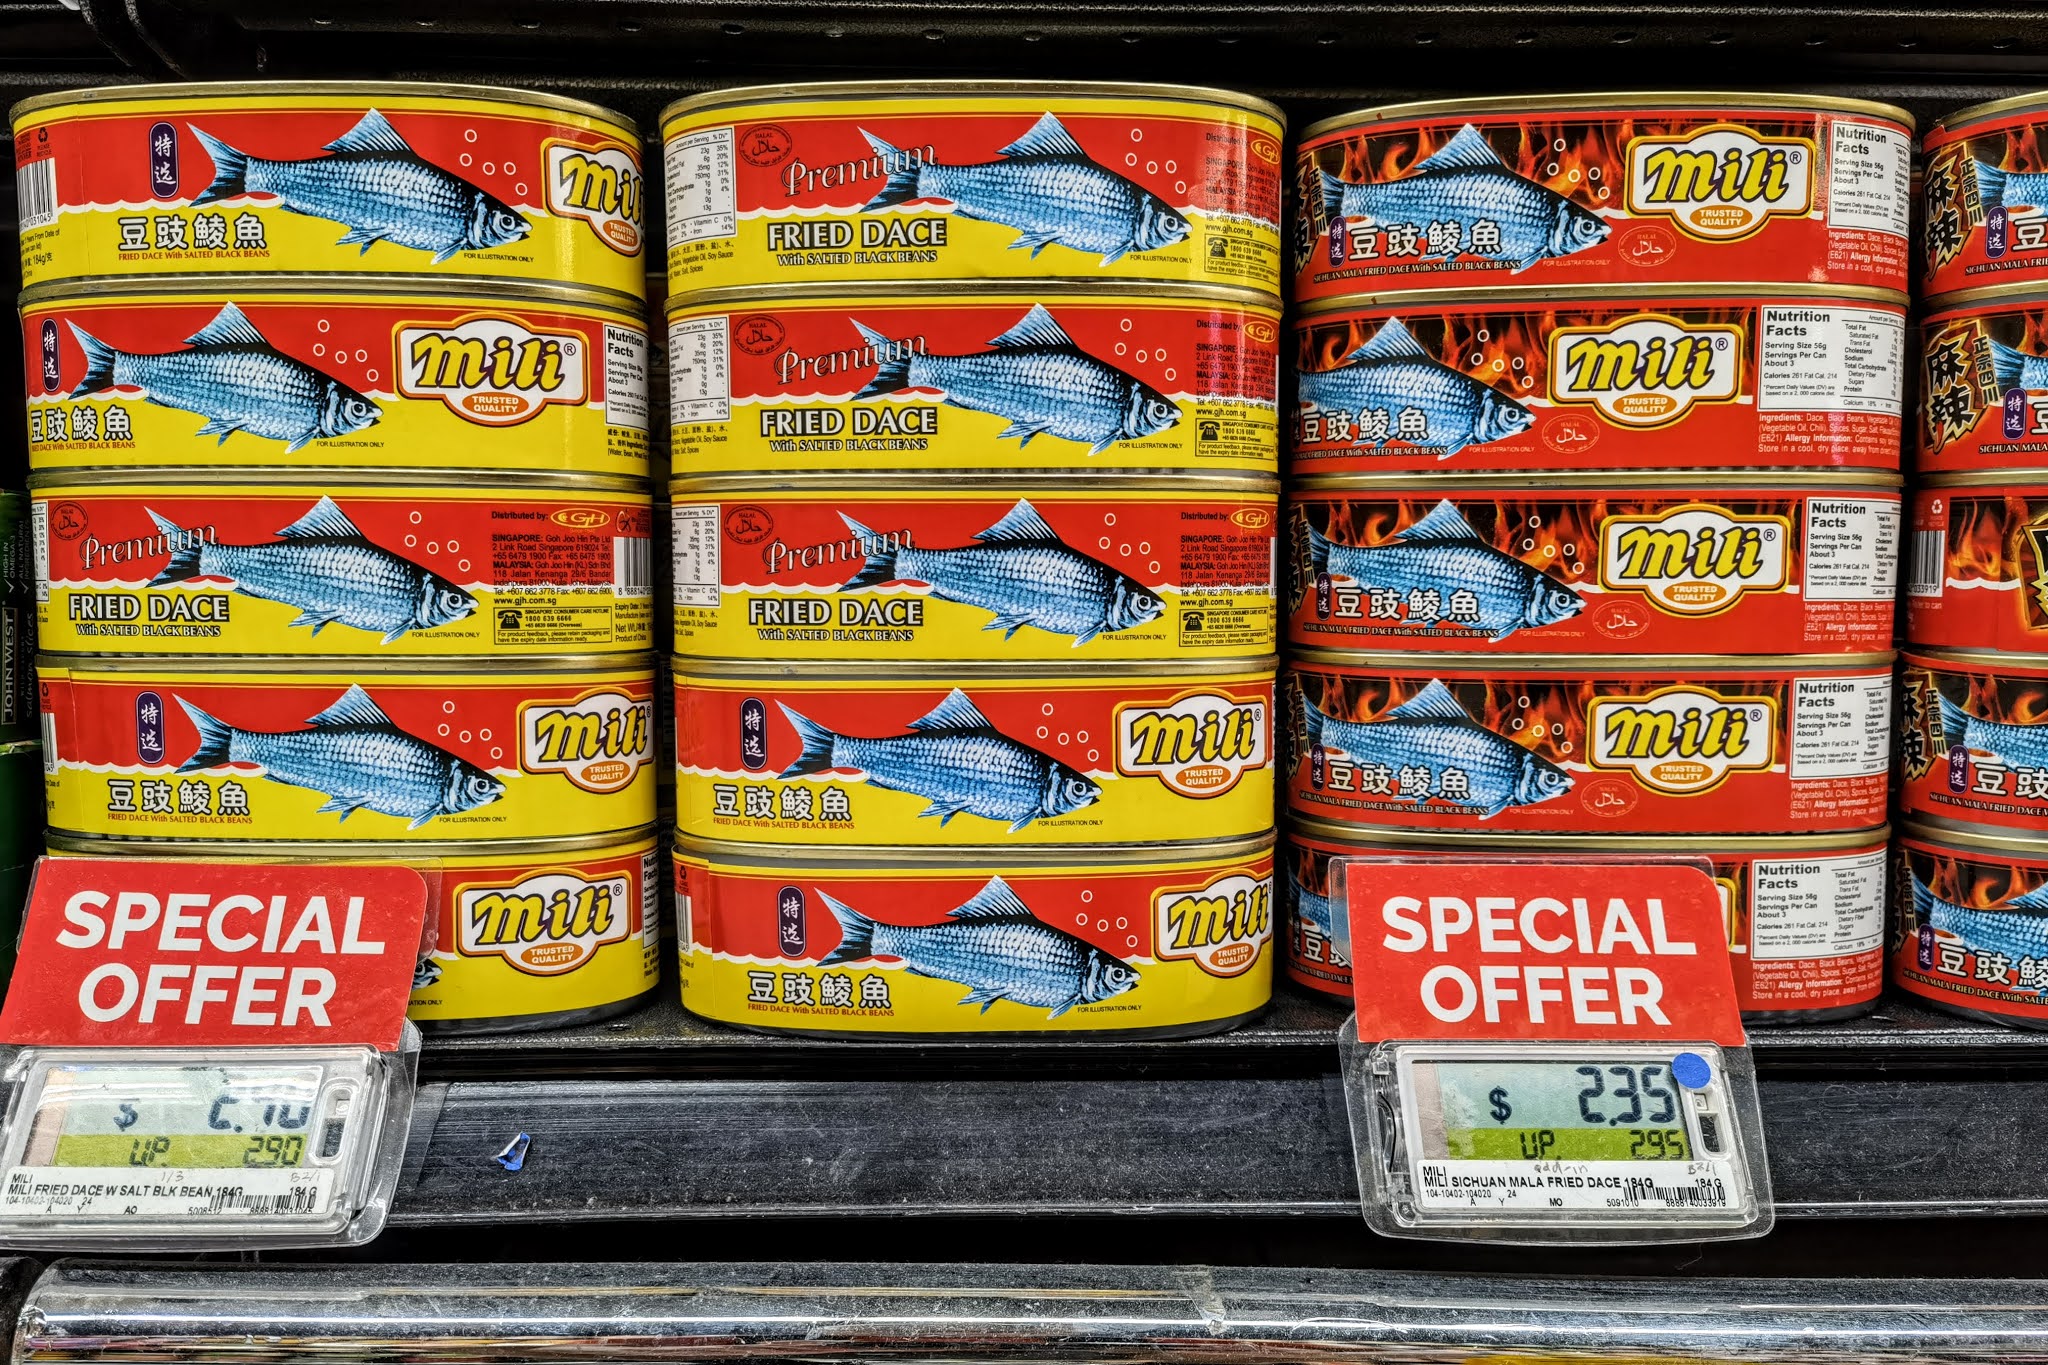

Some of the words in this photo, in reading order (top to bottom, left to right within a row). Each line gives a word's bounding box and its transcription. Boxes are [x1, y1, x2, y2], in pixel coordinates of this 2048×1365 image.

[1835, 127, 1887, 144] Nutrition
[1835, 142, 1869, 155] Facts
[154, 134, 176, 188] 特选
[781, 144, 939, 197] Premium
[1644, 147, 1790, 204] mili
[1699, 208, 1744, 218] TRUSTED
[1700, 217, 1742, 226] QUALITY
[118, 212, 267, 250] 豆豉鯪魚
[609, 222, 635, 237] TRUSTED
[768, 220, 853, 250] FRIED
[861, 218, 947, 248] DACE
[610, 230, 634, 245] QUALITY
[1348, 217, 1503, 260] 豆豉鯪魚
[119, 253, 139, 261] FRIED
[142, 252, 163, 260] DACE
[165, 251, 183, 259] With
[184, 251, 213, 259] SALTED
[216, 250, 241, 258] BLACK
[477, 253, 518, 261] ILLUSTRATION
[776, 253, 805, 266] With
[807, 252, 851, 265] SALTED
[855, 252, 895, 264] BLACK
[897, 250, 937, 263] BEANS
[1767, 310, 1830, 323] Nutrition
[607, 328, 644, 348] Nutrition
[1766, 325, 1807, 336] Facts
[608, 343, 634, 358] Facts
[1814, 342, 1827, 350] 56g
[411, 333, 565, 392] mili
[774, 335, 929, 385] Premium
[1566, 336, 1715, 392] mili
[472, 395, 518, 404] TRUSTED
[1622, 397, 1668, 406] TRUSTED
[473, 404, 517, 413] QUALITY
[1622, 405, 1667, 414] QUALITY
[31, 404, 133, 443] 豆豉鯪魚
[760, 409, 844, 437] FRIED
[852, 407, 937, 436] DACE
[1302, 406, 1430, 443] 豆豉鯪魚
[492, 511, 536, 520] Distributed
[538, 511, 549, 521] by:
[1812, 503, 1866, 515] Nutrition
[1811, 516, 1847, 528] Facts
[80, 525, 219, 571] Premium
[763, 529, 916, 575] Premium
[1617, 526, 1763, 579] mili
[1672, 585, 1718, 593] TRUSTED
[494, 597, 557, 606] www.gjh.com.sg
[1335, 587, 1481, 622] 豆豉鯪魚
[1673, 593, 1717, 602] QUALITY
[69, 594, 141, 621] FRIED
[148, 594, 230, 622] DACE
[749, 598, 832, 626] FRIED
[839, 599, 923, 627] DACE
[76, 624, 98, 635] With
[100, 624, 140, 636] SALTED
[143, 625, 182, 636] BLACK
[183, 625, 221, 637] BEANS
[758, 628, 785, 641] With
[787, 629, 830, 641] SALTED
[833, 629, 873, 641] BLACK
[875, 629, 914, 641] BEANS
[4, 615, 14, 664] WEST
[4, 666, 14, 717] JOHN
[1799, 682, 1855, 695] Nutrition
[1798, 696, 1835, 708] Facts
[140, 702, 161, 754] 特选
[535, 705, 647, 763] mili
[744, 709, 764, 758] 特选
[1605, 706, 1750, 759] mili
[1130, 708, 1255, 765] mili
[589, 763, 625, 772] TRUSTED
[1660, 765, 1704, 773] TRUSTED
[590, 771, 624, 782] QUALITY
[1185, 777, 1222, 785] QUALITY
[1328, 759, 1471, 800] 豆豉鯪魚
[1660, 773, 1703, 781] QUALITY
[107, 778, 251, 816] 豆豉鯪魚
[713, 783, 852, 821] 豆豉鯪魚
[1758, 865, 1820, 876] Nutrition
[1758, 878, 1798, 889] Facts
[56, 889, 386, 956] SPECIAL
[472, 885, 614, 946] mili
[782, 897, 803, 945] 特选
[1168, 883, 1269, 950] mili
[1381, 896, 1697, 957] SPECIAL
[530, 946, 574, 956] TRUSTED
[531, 953, 574, 964] QUALITY
[1217, 946, 1249, 957] TRUSTED
[1218, 955, 1248, 965] QUALITY
[78, 962, 338, 1028] OFFER
[748, 971, 891, 1009] 豆豉鯪魚
[1420, 964, 1672, 1028] OFFER
[1488, 1086, 1512, 1125] $
[1576, 1065, 1677, 1126] 2.35
[1423, 1165, 1448, 1176] MILI
[12, 1174, 33, 1184] MILI
[1424, 1176, 1449, 1188] MILI
[1451, 1177, 1507, 1188] SICHUAN
[1509, 1177, 1545, 1188] MALA
[1548, 1177, 1584, 1188] FRIED
[1587, 1177, 1622, 1188] DACE
[1624, 1178, 1653, 1188] 184G
[1695, 1179, 1711, 1188] 184
[1713, 1179, 1722, 1188] G
[8, 1184, 34, 1196] MILI
[36, 1184, 70, 1196] FRIED
[71, 1185, 103, 1196] DACE
[105, 1185, 118, 1196] W
[120, 1185, 151, 1197] SALT
[152, 1186, 177, 1197] BLK
[179, 1186, 213, 1198] BEAN
[216, 1187, 243, 1197] 184G
[289, 1187, 305, 1197] 184
[306, 1187, 318, 1197] G
[1426, 1190, 1492, 1198] 104-10402-104020
[1549, 1198, 1563, 1207] MO
